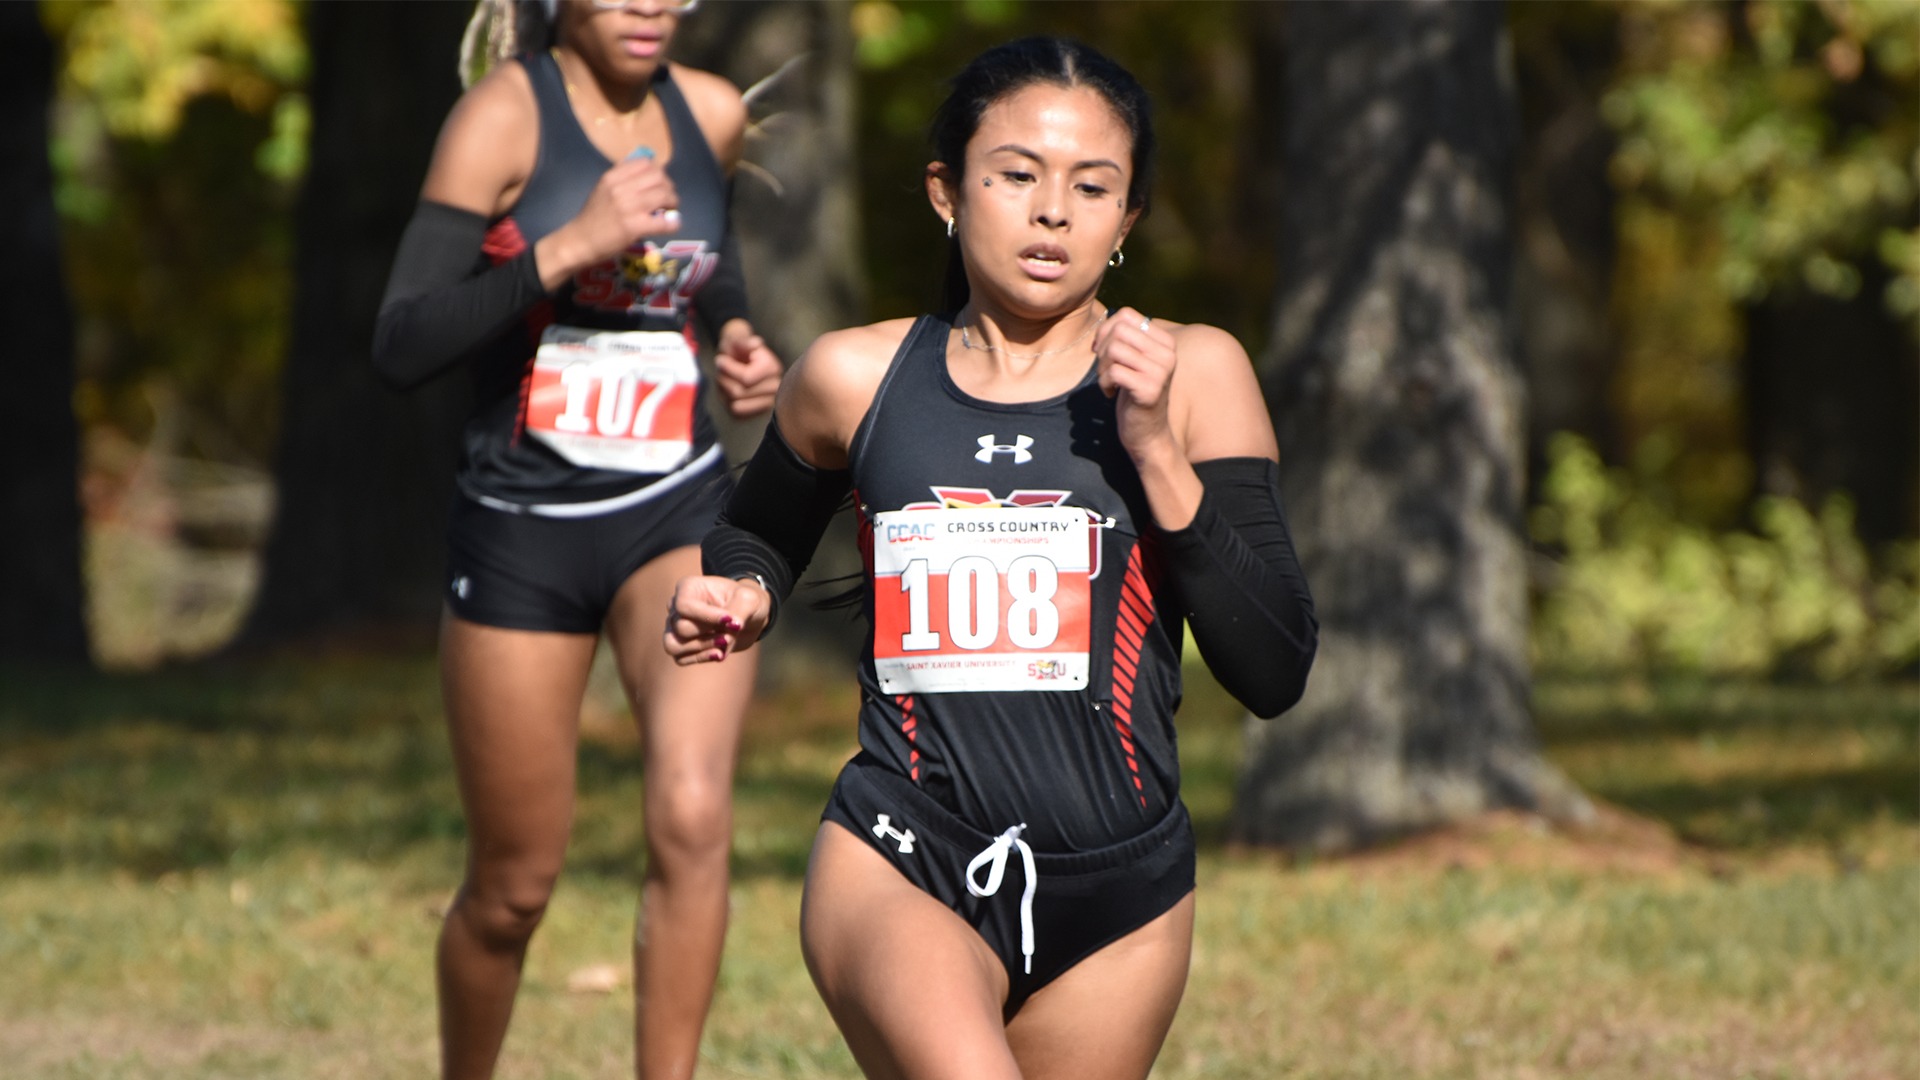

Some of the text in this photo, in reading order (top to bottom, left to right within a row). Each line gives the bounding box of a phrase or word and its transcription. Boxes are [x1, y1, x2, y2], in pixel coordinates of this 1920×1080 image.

[555, 361, 676, 438] 107
[887, 523, 935, 543] CCAC
[947, 521, 1069, 532] CROSS COUNTRY
[901, 554, 1059, 651] 108
[905, 661, 928, 670] SAINT
[932, 660, 961, 669] XAVIER
